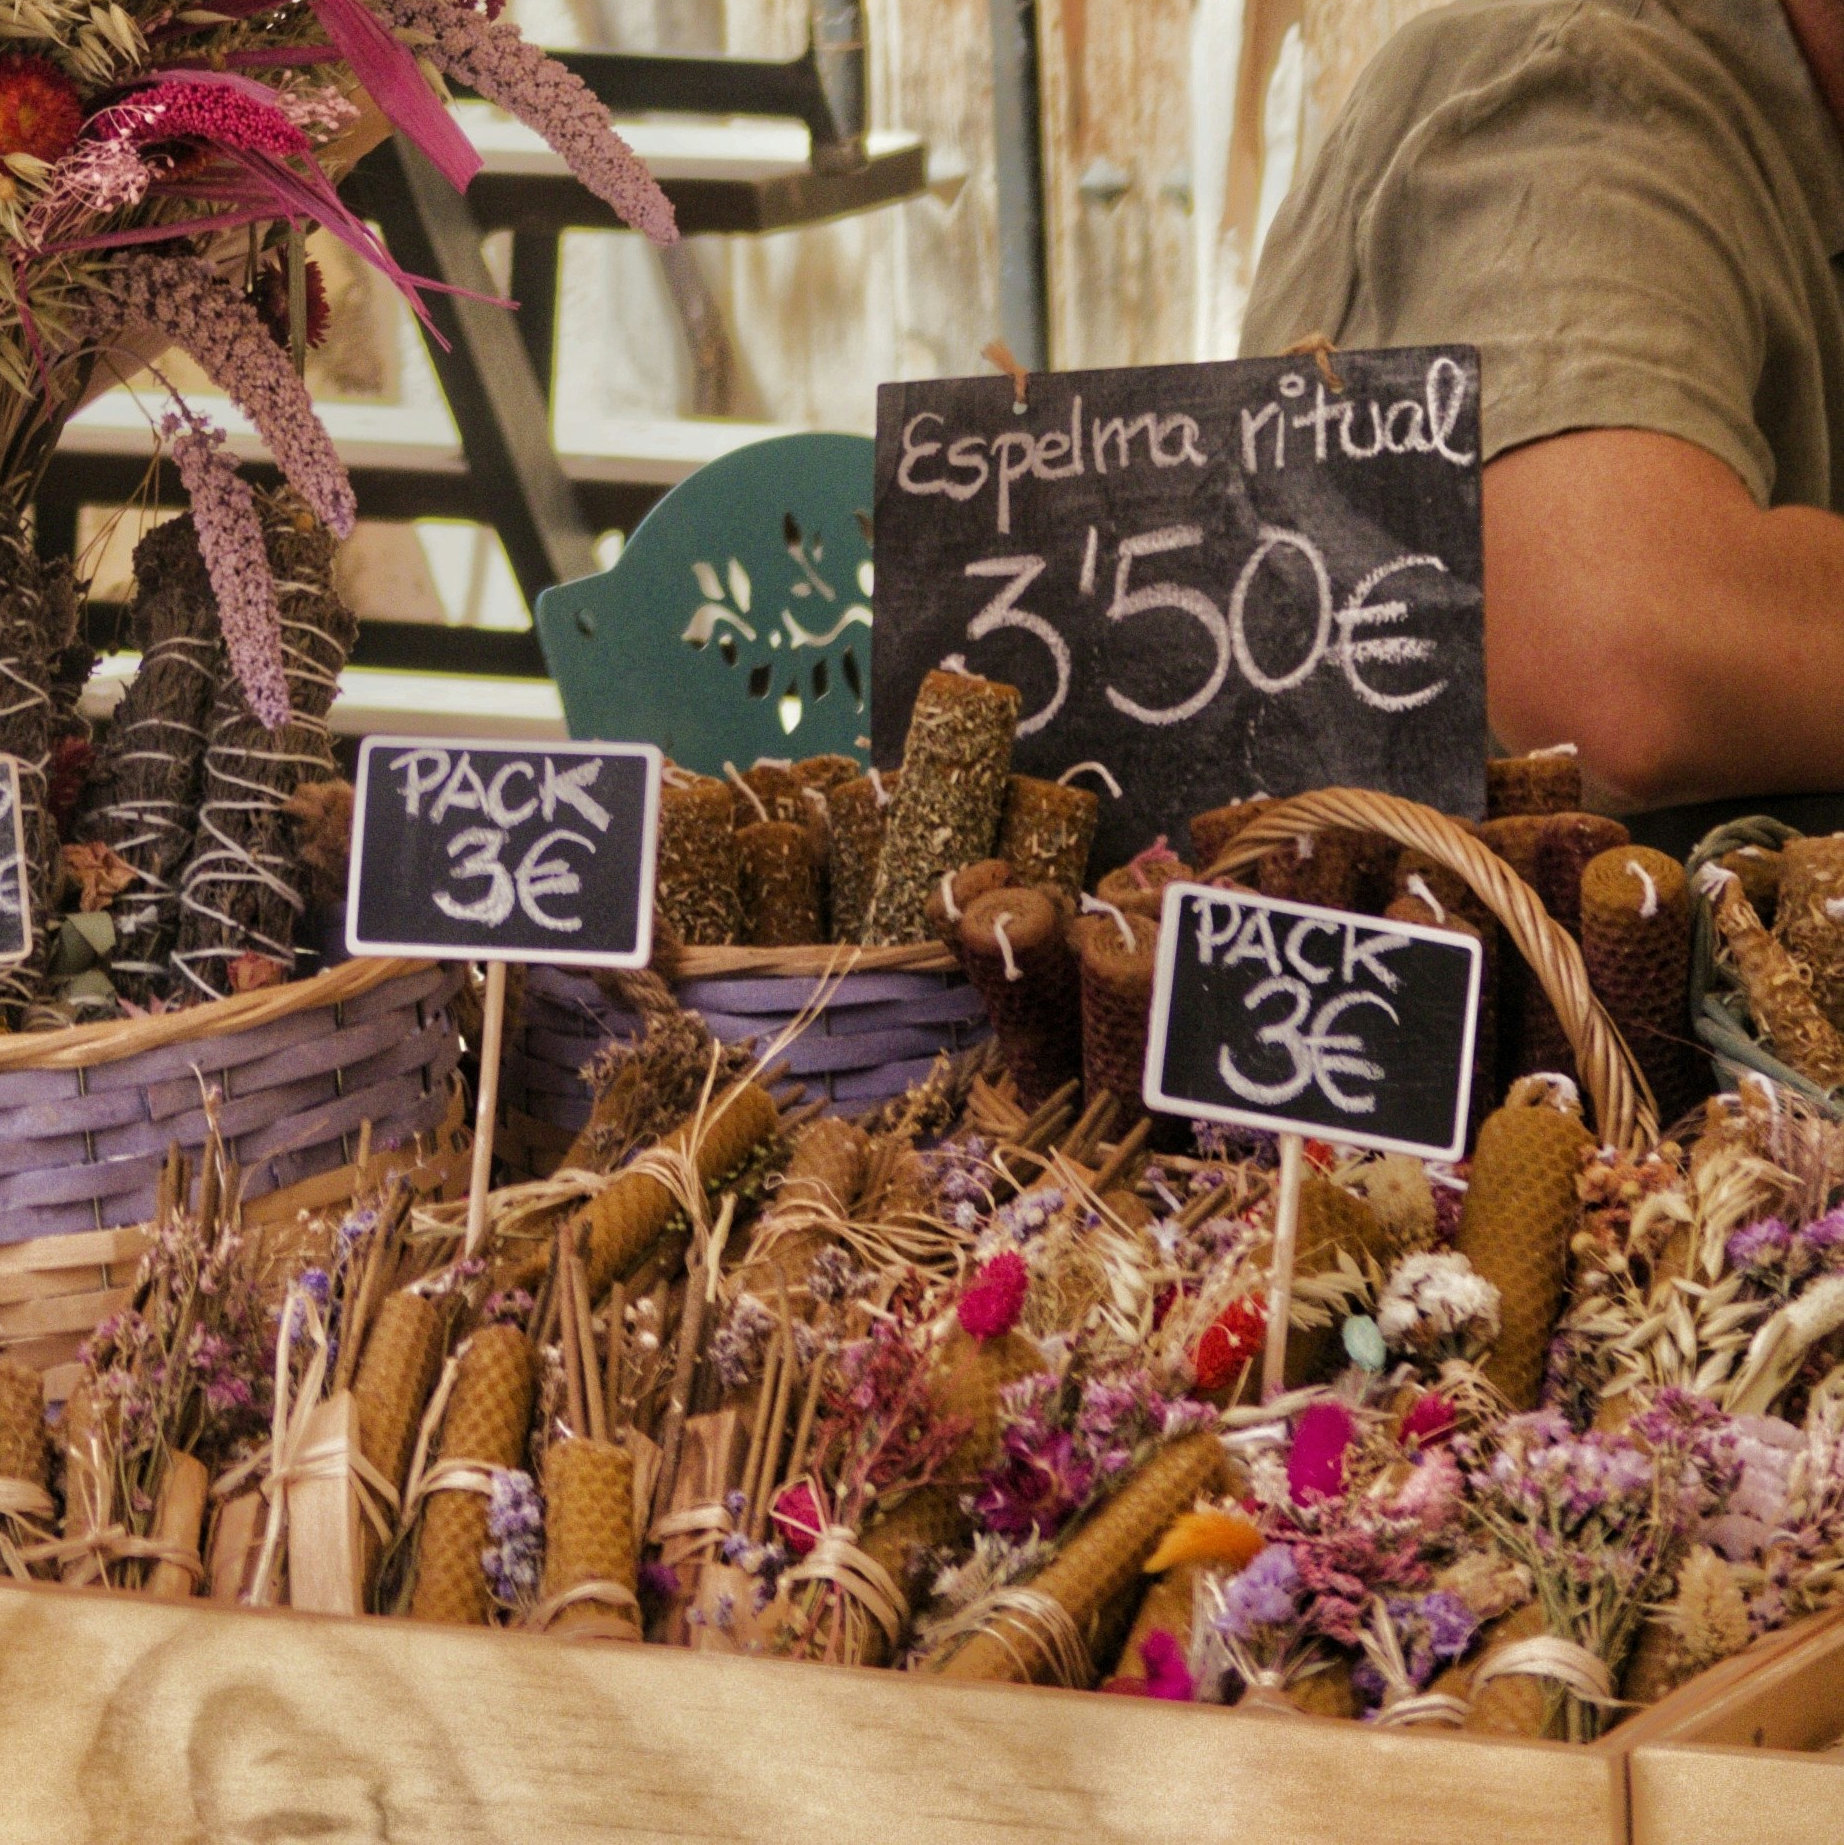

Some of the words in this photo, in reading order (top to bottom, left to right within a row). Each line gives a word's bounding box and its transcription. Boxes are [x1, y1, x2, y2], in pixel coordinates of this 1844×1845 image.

[897, 394, 1208, 534] Espelma
[1241, 356, 1474, 473] ritual
[389, 748, 614, 832] PACK
[432, 826, 598, 933] 3€
[1192, 896, 1411, 994] PACK
[1218, 975, 1401, 1113] 3€
